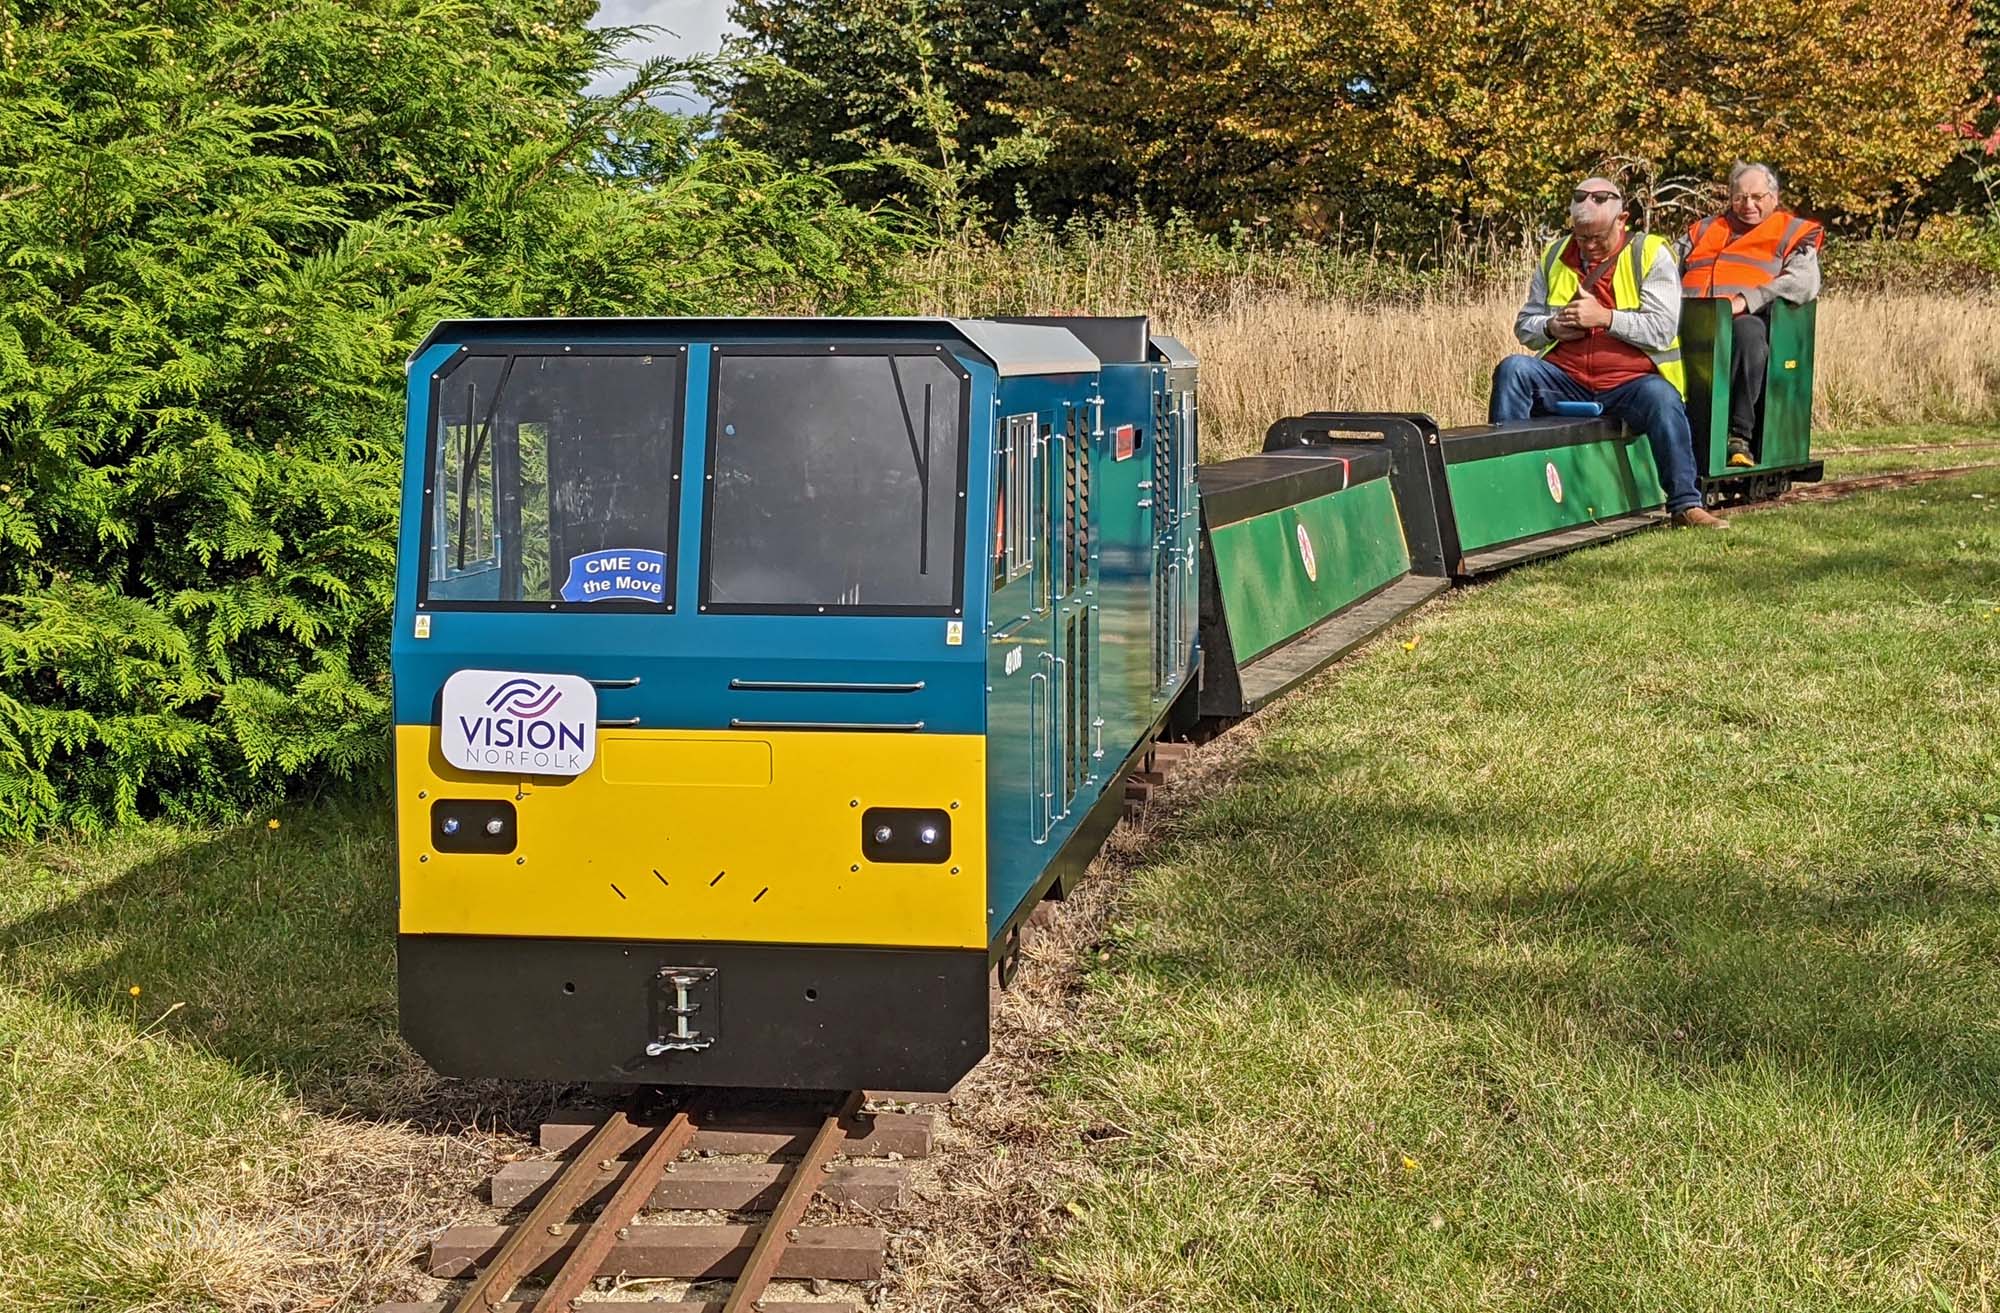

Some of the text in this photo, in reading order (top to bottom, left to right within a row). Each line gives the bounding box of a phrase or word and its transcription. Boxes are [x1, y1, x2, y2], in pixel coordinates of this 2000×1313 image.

[1429, 433, 1437, 444] 2
[585, 557, 661, 574] CME on
[583, 576, 662, 594] the Move
[459, 716, 585, 752] VISION
[466, 748, 580, 769] NORFOLK
